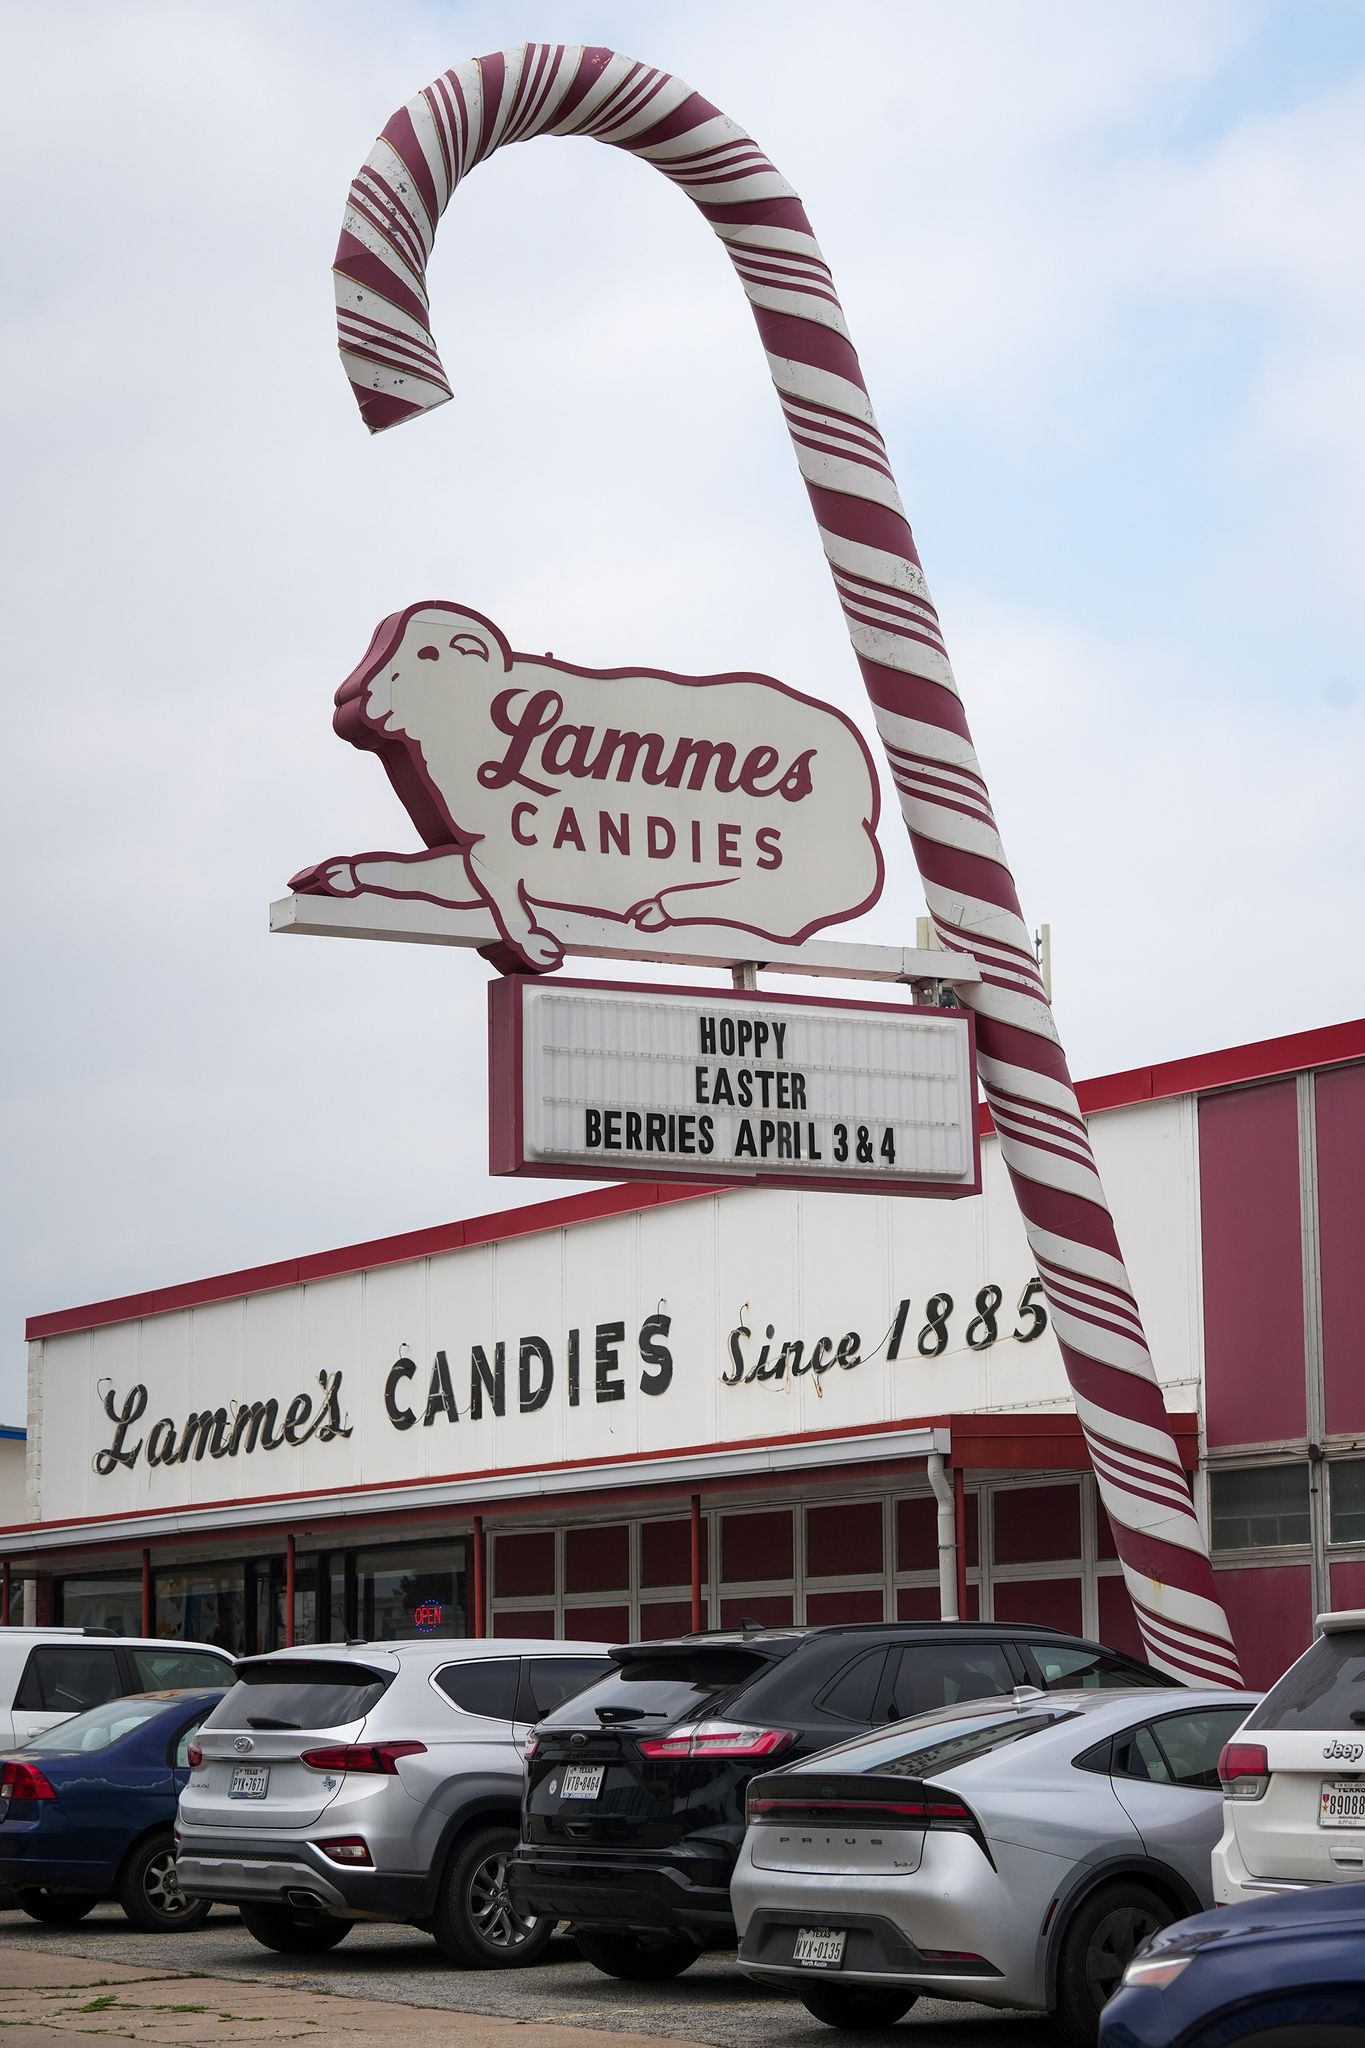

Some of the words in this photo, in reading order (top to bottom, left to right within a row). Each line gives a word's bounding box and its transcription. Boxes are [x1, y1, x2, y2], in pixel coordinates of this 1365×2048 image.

[476, 688, 818, 802] Lammes
[511, 801, 783, 870] CANDIES
[699, 1016, 787, 1059] HOPPY
[695, 1066, 807, 1110] EASTER
[585, 1109, 714, 1155] BERRIES
[734, 1119, 822, 1160] APRIL
[94, 1369, 354, 1475] Lamme's
[385, 1314, 673, 1431] CANDIES
[721, 1323, 862, 1386] Since
[886, 1277, 1048, 1362] 1885
[415, 1607, 442, 1625] OPEN
[244, 1768, 259, 1776] TEXAS
[1322, 1739, 1364, 1763] Jeep
[779, 1836, 883, 1845] PRIUS
